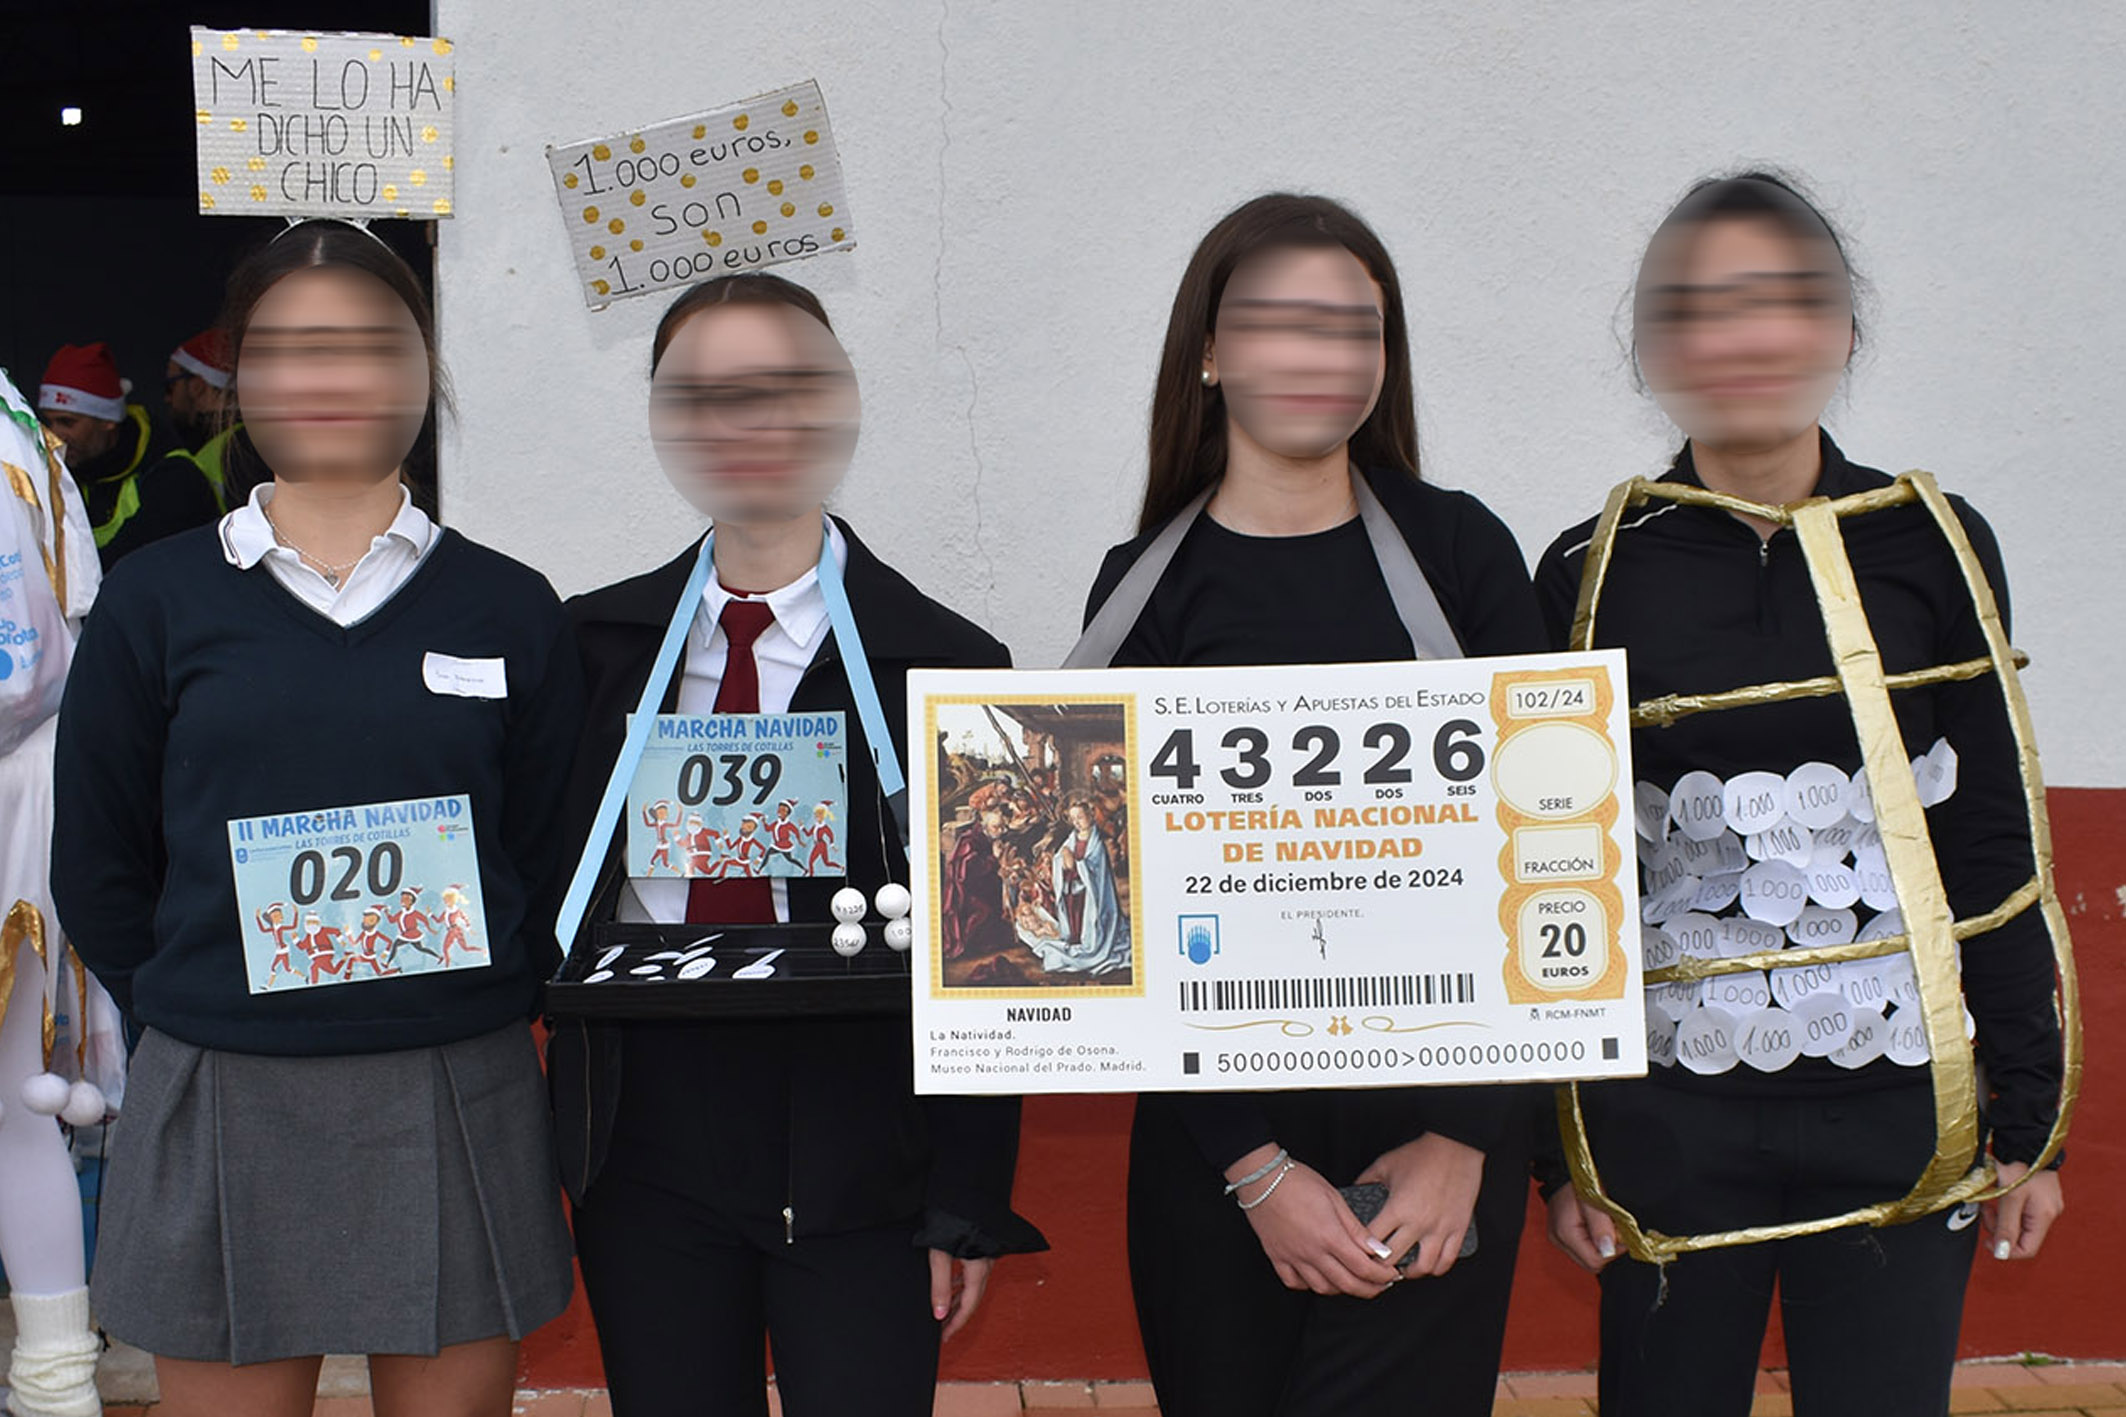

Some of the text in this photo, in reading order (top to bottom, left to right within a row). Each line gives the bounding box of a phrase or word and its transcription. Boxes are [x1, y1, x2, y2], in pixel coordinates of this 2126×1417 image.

[211, 56, 441, 110] ME LO HA
[258, 113, 413, 159] DICHO UN
[573, 130, 792, 196] 1.000 euros,
[281, 161, 378, 205] CHICO
[608, 233, 820, 296] 1.000 euros
[1516, 688, 1585, 710] 102/24
[657, 716, 838, 740] MARCHA NAVIDAD
[687, 743, 705, 752] LAS
[705, 742, 741, 752] TORRES
[741, 742, 754, 751] DE
[753, 741, 795, 751] COTILLAS
[677, 752, 783, 806] 039
[1151, 784, 1477, 805] CUATRO TRES DOS DOS SEIS
[1538, 797, 1573, 811] SERIE
[237, 798, 463, 842] II MARCHA NAVIDAD
[1164, 803, 1479, 832] LOTERÍA NACIONAL
[295, 839, 313, 850] LAS
[352, 832, 367, 843] DE
[367, 828, 412, 842] COTILLAS
[1222, 837, 1423, 863] DE NAVIDAD
[289, 841, 404, 906] 020
[1524, 856, 1594, 875] FRACCIÓN
[1185, 868, 1465, 894] 22 de diciembre de 2024
[1280, 910, 1294, 920] EL
[1538, 900, 1586, 915] PRECIO
[1539, 922, 1587, 959] 20
[1541, 965, 1590, 979] EUROS
[1006, 1006, 1073, 1023] NAVIDAD
[930, 1029, 1017, 1041] La Natividad.
[930, 1046, 991, 1058] Francisco
[993, 1048, 1002, 1060] y
[1005, 1045, 1055, 1060] Rodrigo
[1057, 1045, 1073, 1057] de
[930, 1063, 972, 1075] Museo
[975, 1062, 1030, 1074] Nacional
[1032, 1061, 1053, 1073] del
[1099, 1060, 1148, 1072] Madrid.
